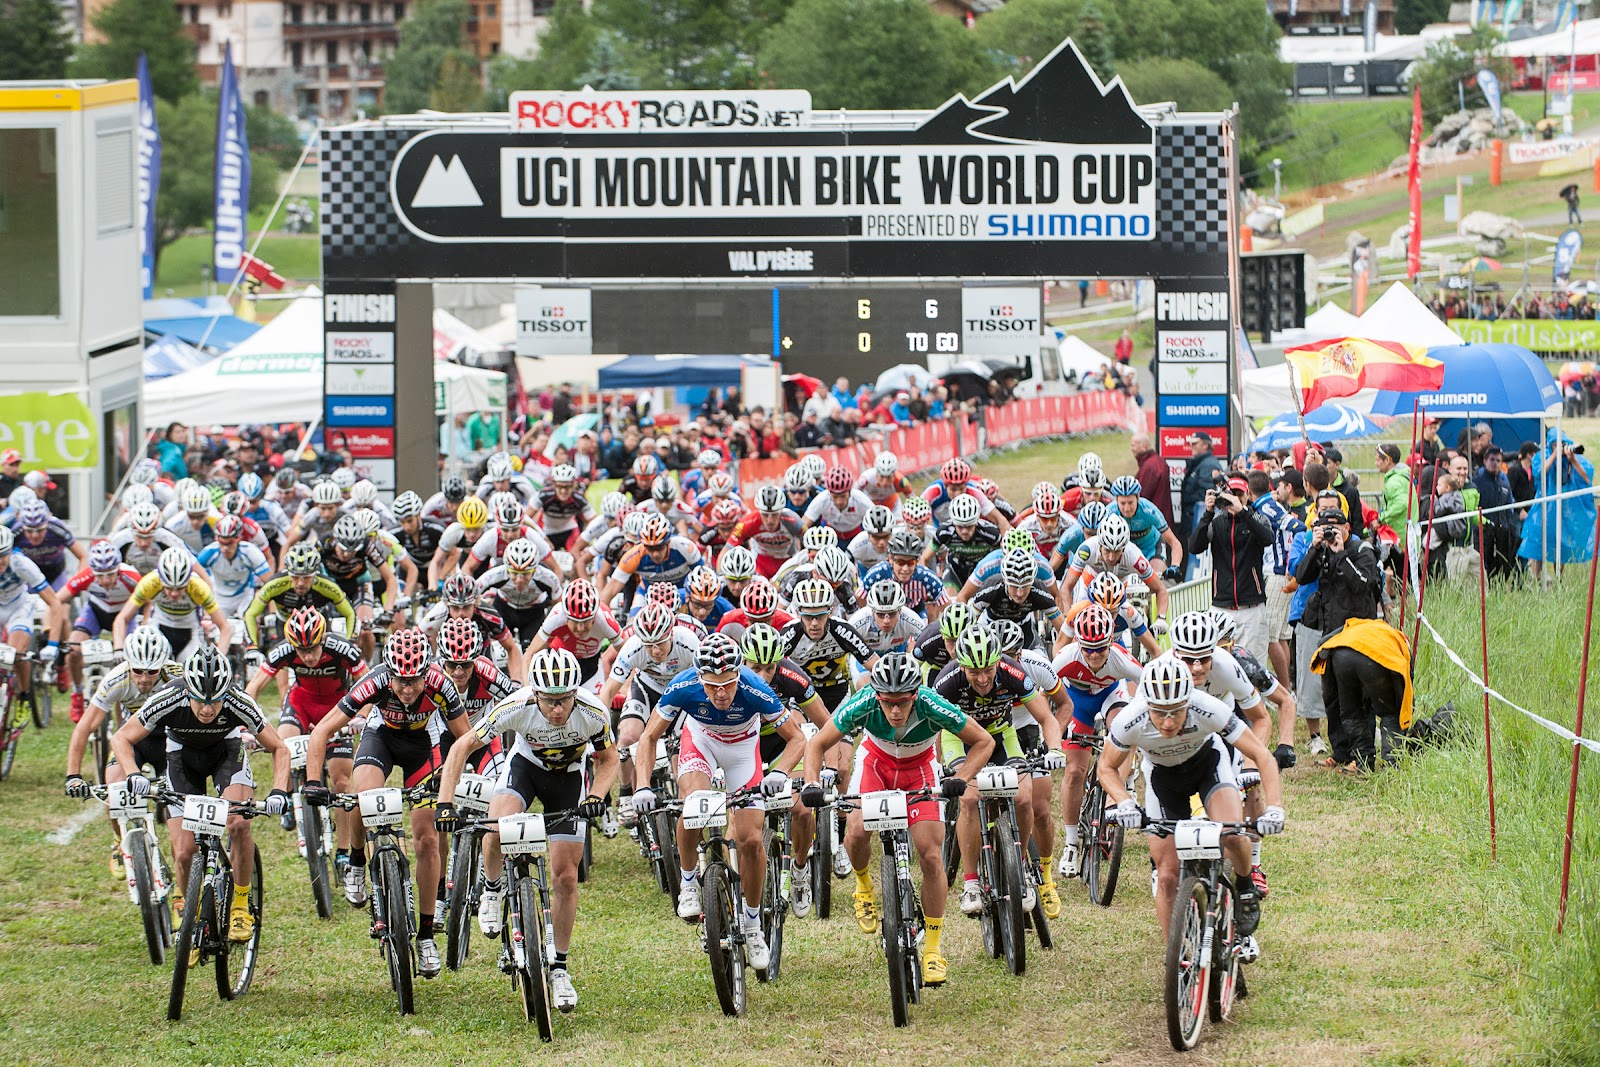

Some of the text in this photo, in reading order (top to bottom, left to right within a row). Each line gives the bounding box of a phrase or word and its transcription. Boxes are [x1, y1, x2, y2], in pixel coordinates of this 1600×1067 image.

[517, 154, 1153, 208] UCI MOUNTAIN BIKE WORLD CUP
[867, 214, 1150, 237] PRESENTED BY SHIMANO
[728, 250, 755, 272] VAL
[325, 293, 396, 323] FINISH
[857, 299, 939, 319] 6 6
[1157, 291, 1229, 321] FINISH
[518, 319, 588, 332] TISSOT
[965, 319, 1038, 332] TISSOT
[906, 332, 928, 352] TO
[936, 332, 959, 352] GO
[1165, 337, 1206, 347] ROCKY
[1418, 393, 1488, 406] SHIMANO
[1165, 405, 1220, 416] SHIMANO
[324, 636, 362, 661] BMC
[834, 624, 870, 657] MAXXIS
[268, 641, 295, 663] BM
[475, 660, 495, 680] WILD
[352, 680, 376, 702] WILD
[663, 677, 699, 696] ORBE
[464, 780, 483, 798] 14
[987, 771, 1006, 788] 11
[119, 790, 137, 807] 38
[375, 795, 386, 813] 8
[699, 798, 709, 814] 6
[879, 798, 890, 817] 4
[196, 803, 217, 821] 19
[516, 821, 526, 840] 7
[1193, 827, 1201, 846] 1
